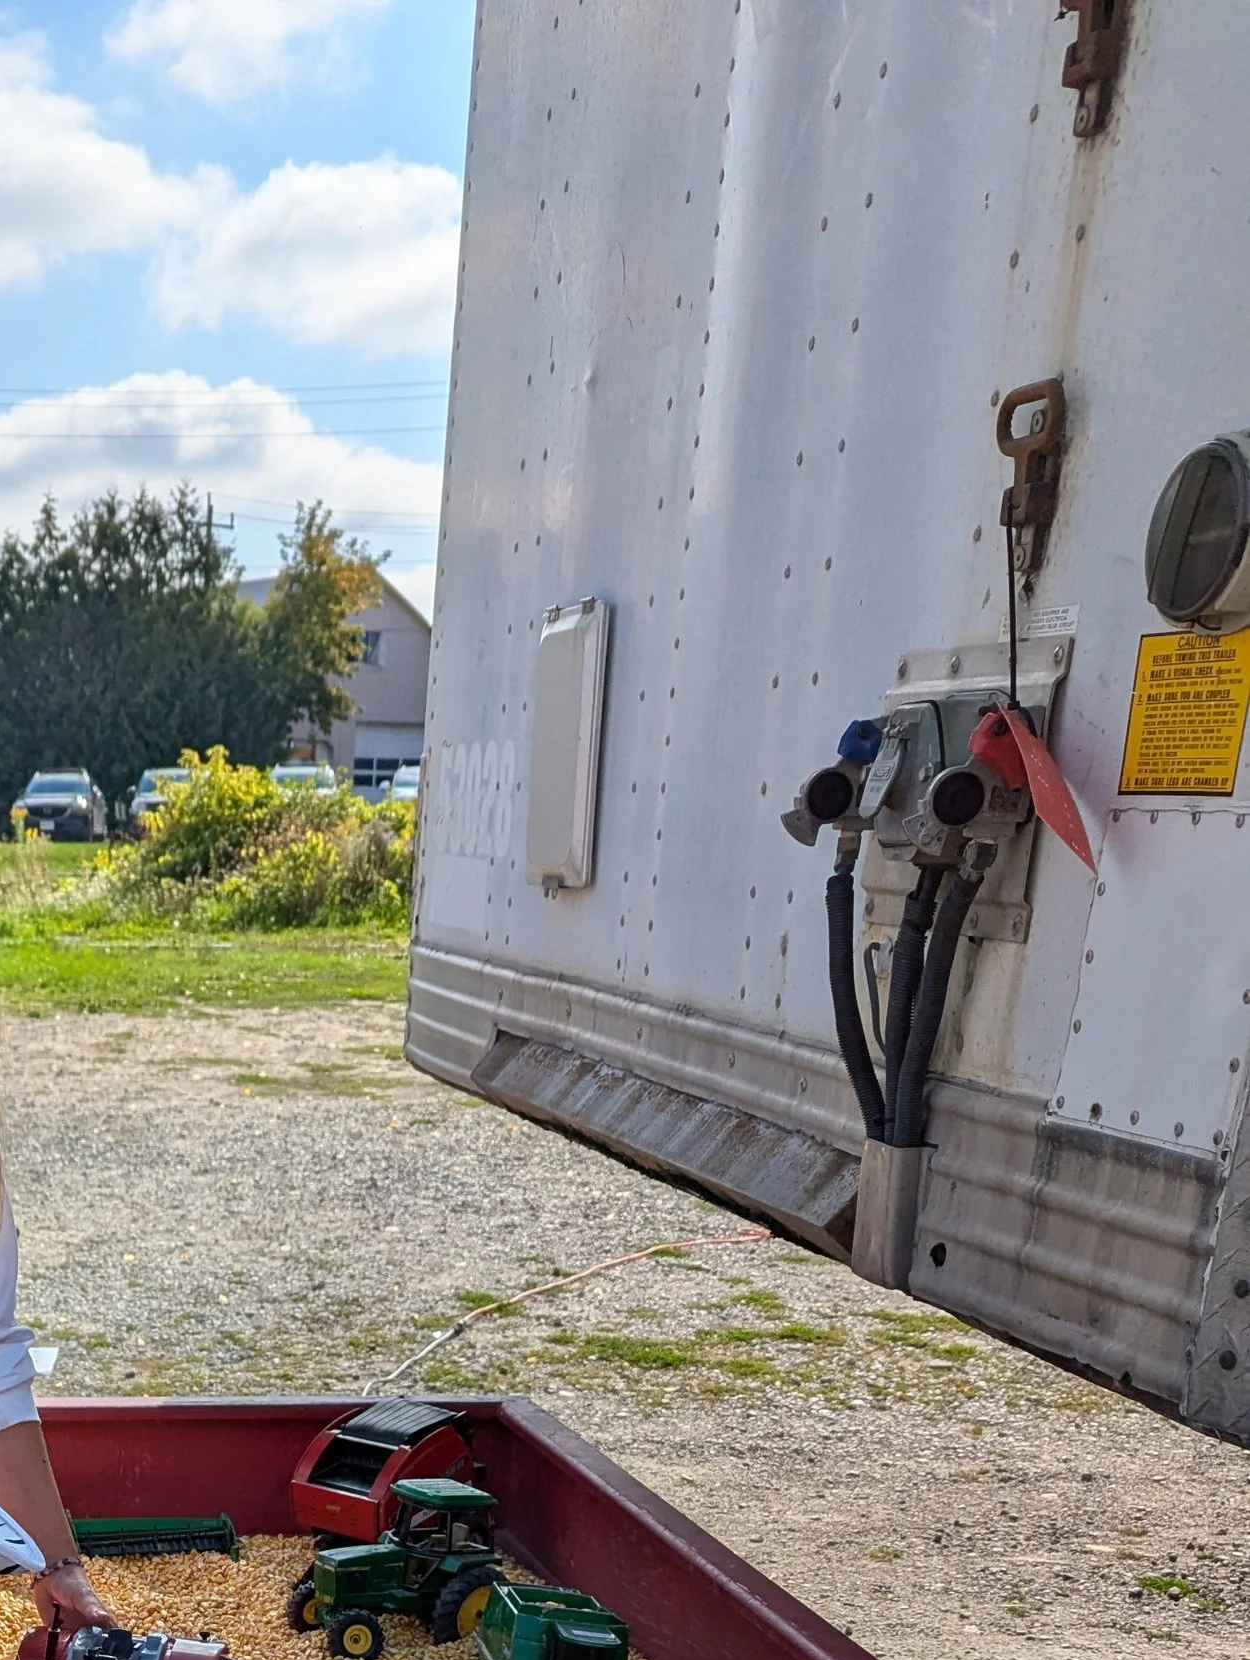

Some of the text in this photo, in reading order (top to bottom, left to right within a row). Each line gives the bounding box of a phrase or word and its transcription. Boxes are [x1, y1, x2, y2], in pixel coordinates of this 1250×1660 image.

[1178, 634, 1220, 648] CAUTION
[1152, 653, 1173, 664] BEFORE
[1199, 650, 1212, 660] THIS
[1213, 648, 1236, 659] TRAILER
[1150, 668, 1167, 679] MAKE
[1147, 691, 1162, 702] MAKE
[1134, 777, 1149, 787] MAKE
